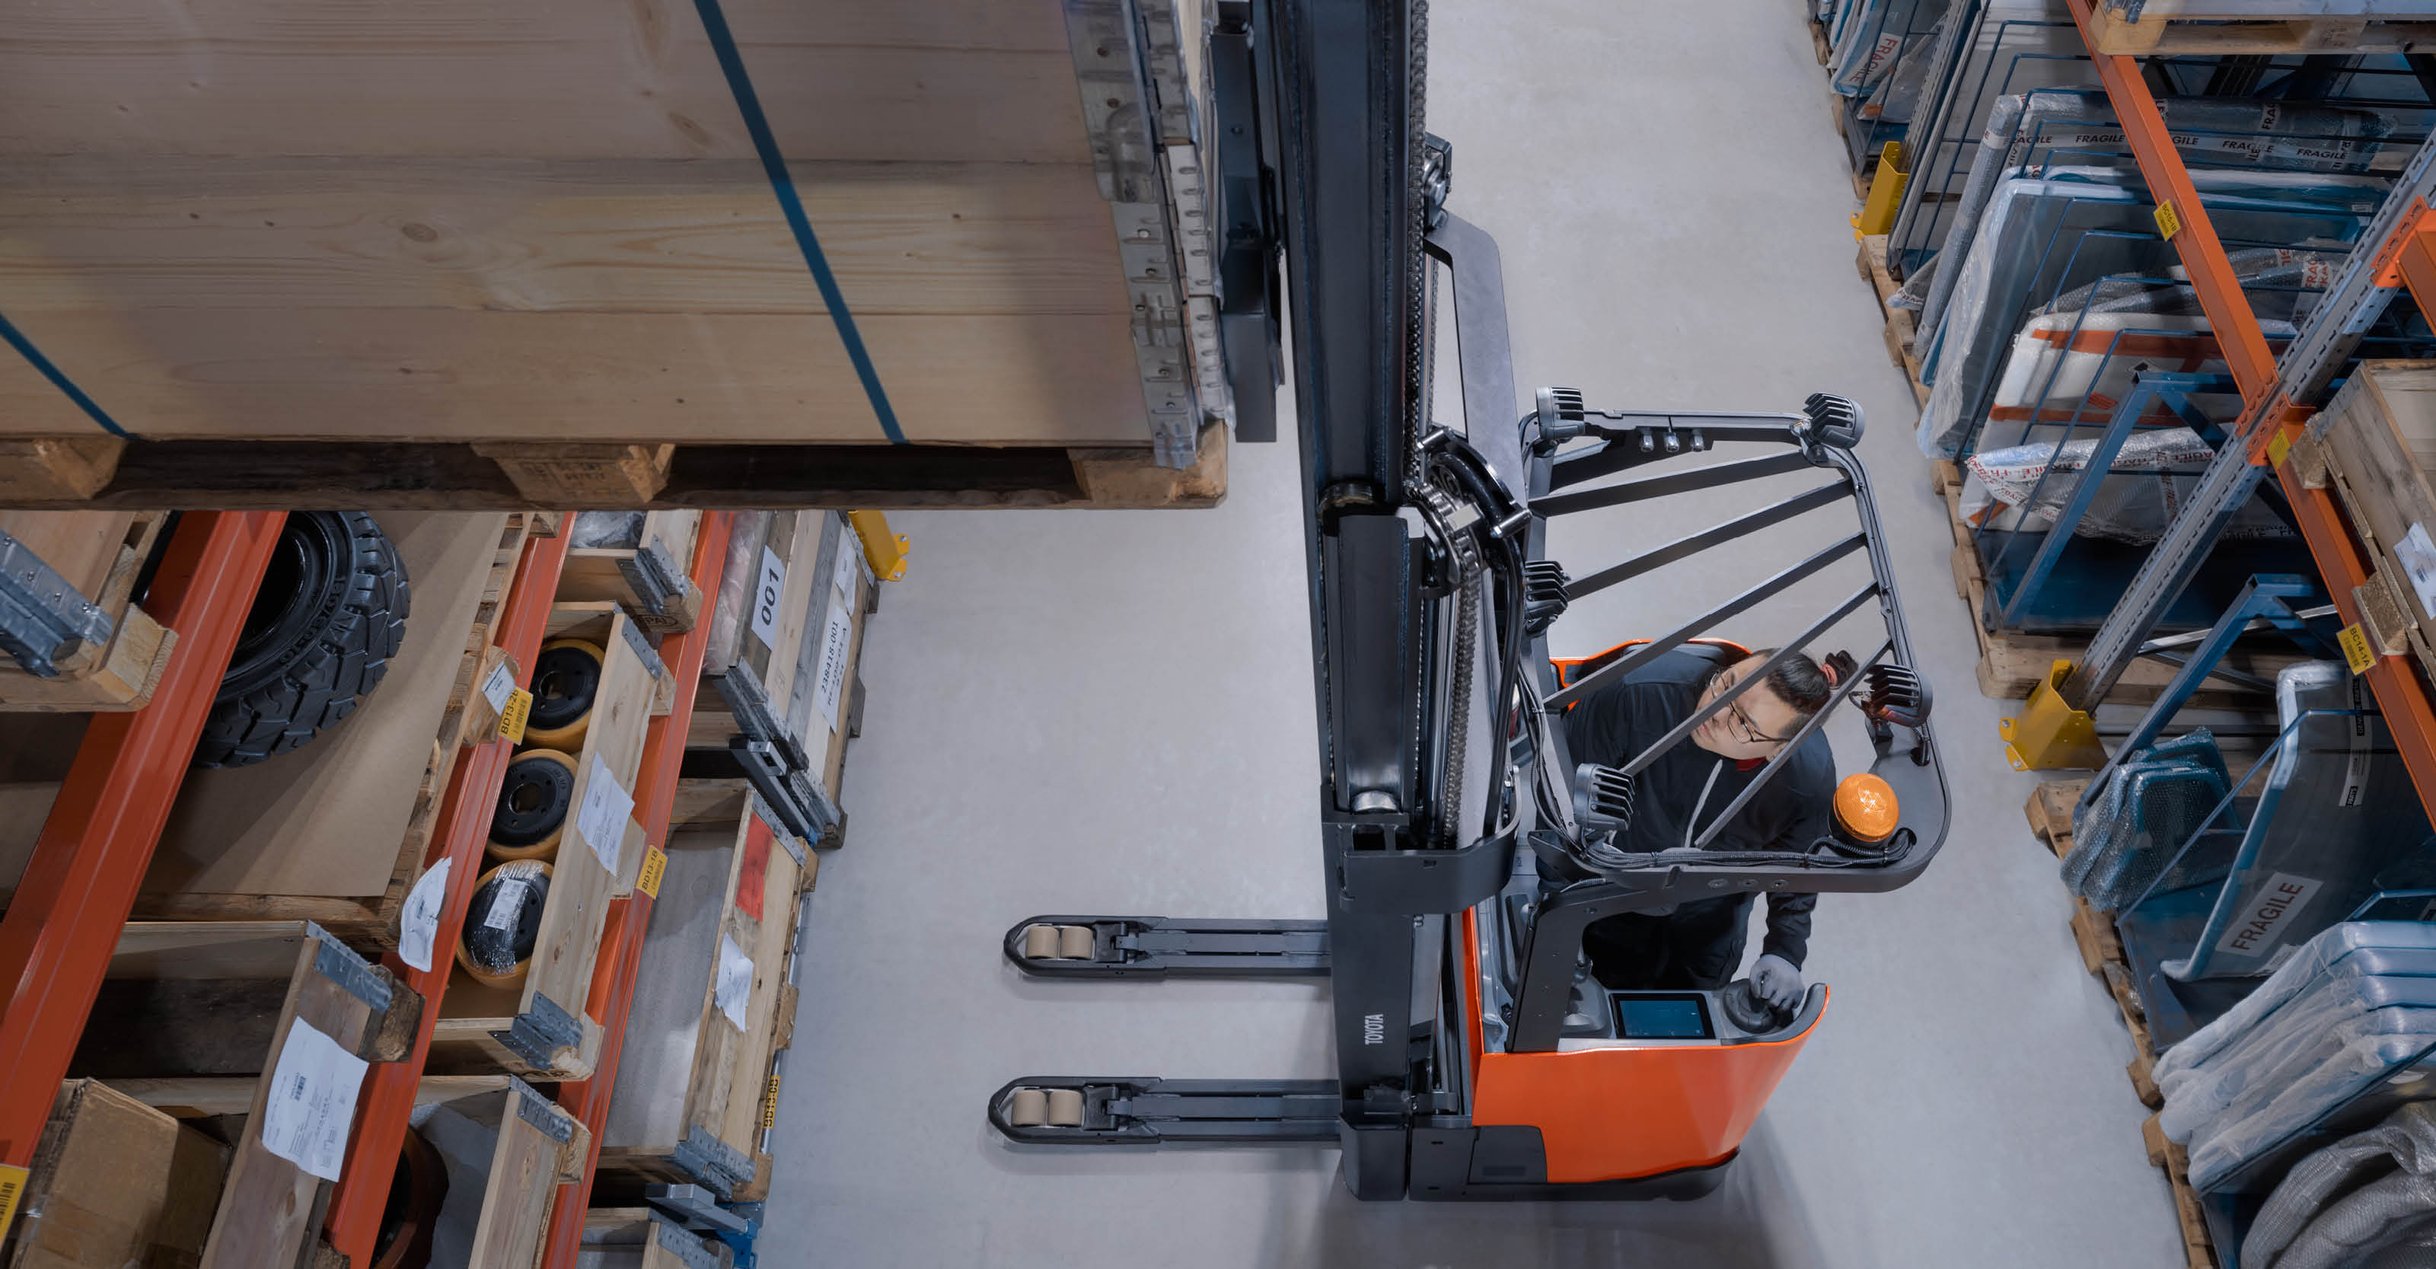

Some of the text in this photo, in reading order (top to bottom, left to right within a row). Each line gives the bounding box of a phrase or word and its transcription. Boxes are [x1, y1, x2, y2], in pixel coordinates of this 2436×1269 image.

[2075, 134, 2126, 143] FRAGILE
[761, 567, 779, 626] 001
[2349, 628, 2371, 667] BC14-1A
[641, 850, 658, 890] BD13-1B
[2230, 882, 2304, 950] FRAGILE
[1364, 1013, 1384, 1045] TOYOTA
